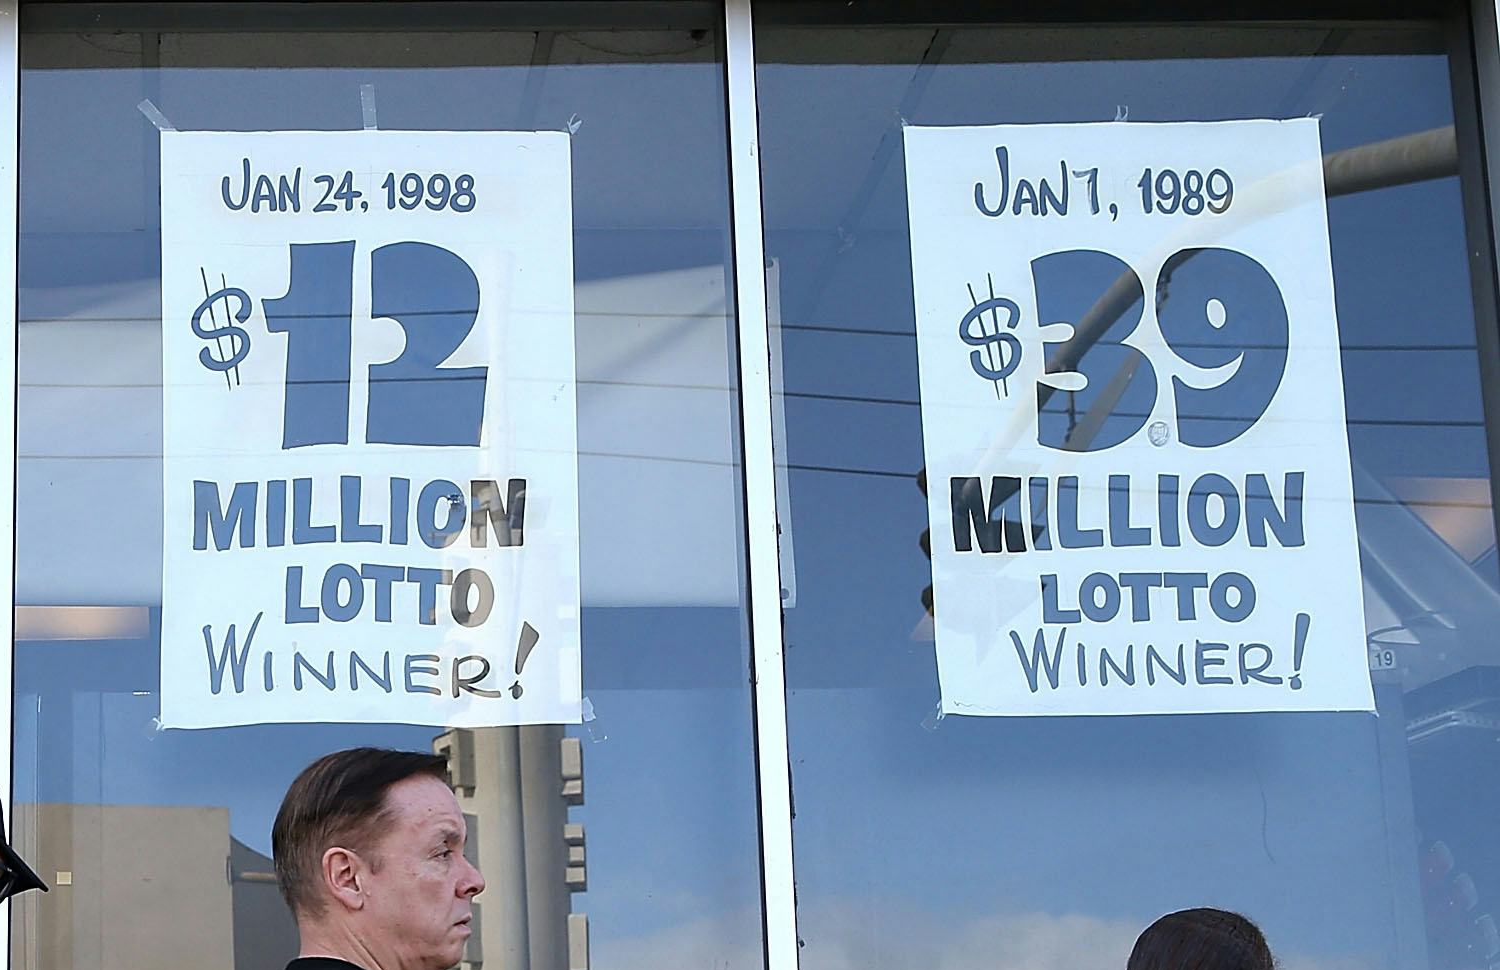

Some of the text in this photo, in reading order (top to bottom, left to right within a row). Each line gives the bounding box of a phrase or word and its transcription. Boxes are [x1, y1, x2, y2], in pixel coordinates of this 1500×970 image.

[222, 158, 476, 213] JAN 24, 1998
[975, 146, 1068, 217] JAN
[1137, 168, 1233, 216] 1989
[193, 475, 526, 552] MILLION
[950, 471, 1305, 554] MILLION
[285, 563, 494, 627] LOTTO
[1040, 572, 1256, 624] LOTTO
[203, 611, 539, 700] WINNER!
[1009, 613, 1310, 693] WINNER!
[1375, 651, 1393, 666] 19
